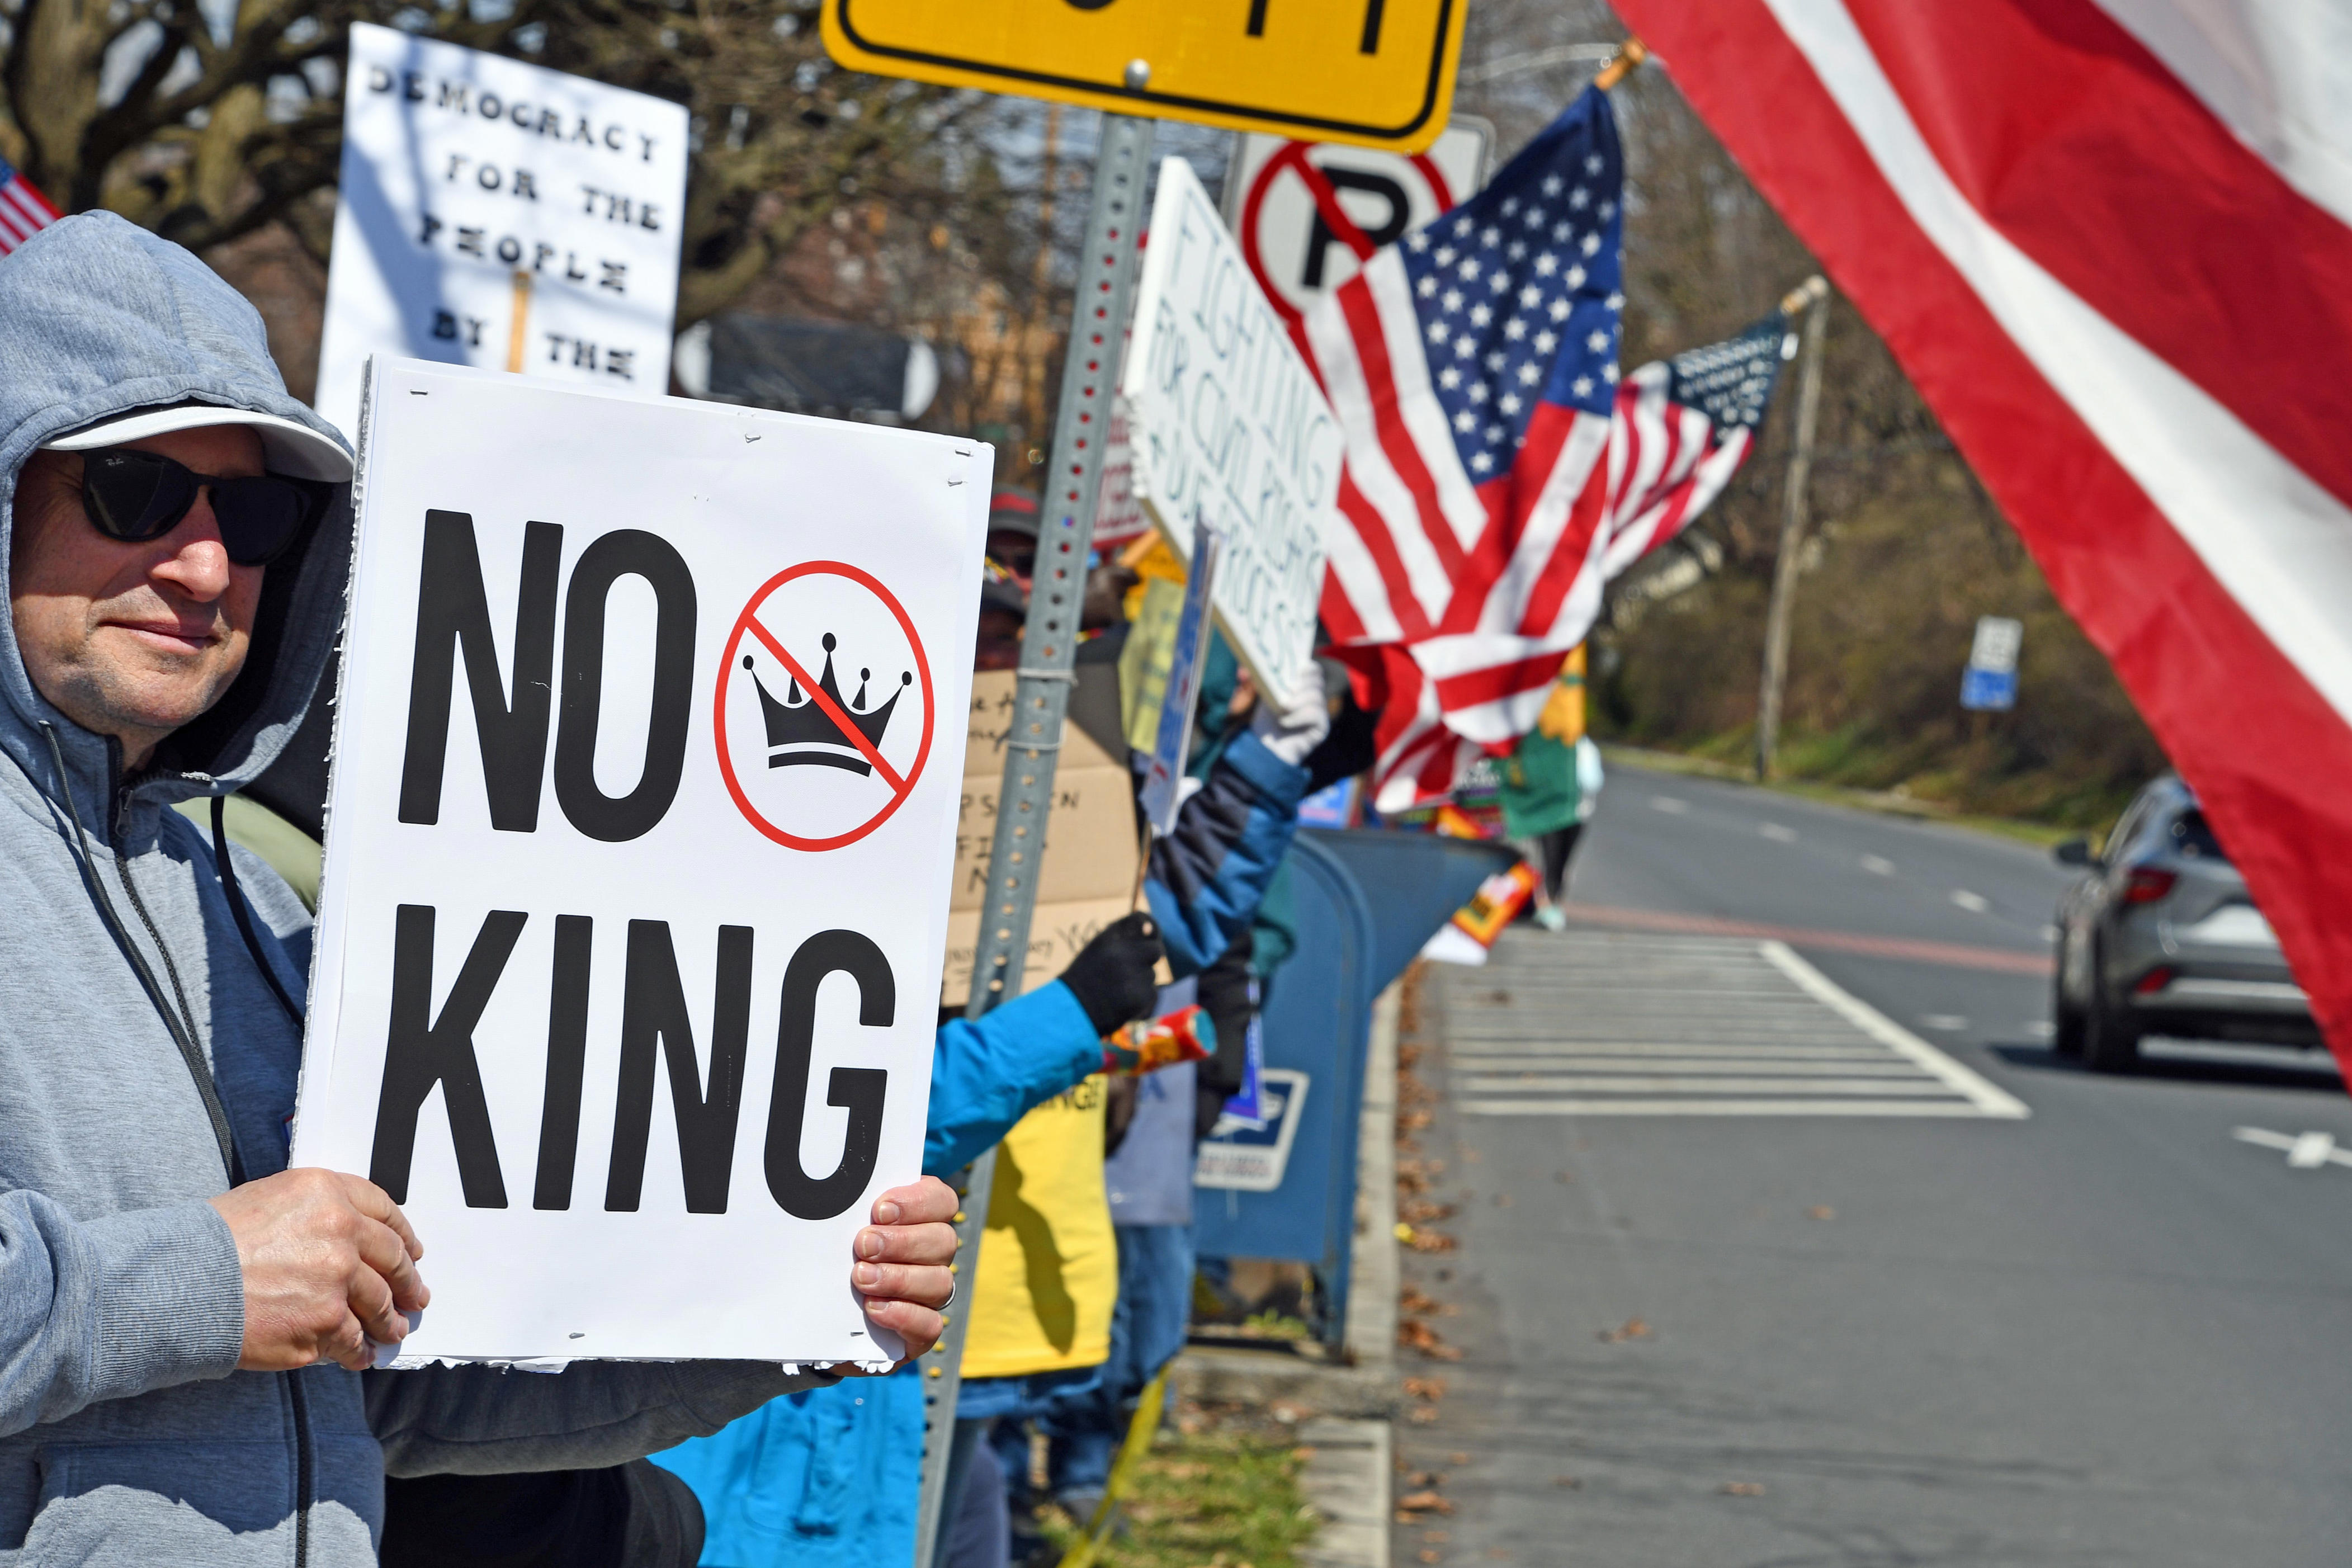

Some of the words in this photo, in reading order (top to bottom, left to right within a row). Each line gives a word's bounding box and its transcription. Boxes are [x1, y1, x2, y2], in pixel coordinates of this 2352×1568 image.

[367, 66, 659, 161] DEMOCRACY
[446, 154, 537, 200] FOR
[580, 187, 659, 230] THE
[419, 216, 627, 293] PEOPLE
[431, 310, 488, 347] BY
[545, 334, 634, 379] THE
[1170, 186, 1329, 508] FIGHTING
[398, 509, 697, 842] NO
[369, 904, 895, 1220] KING
